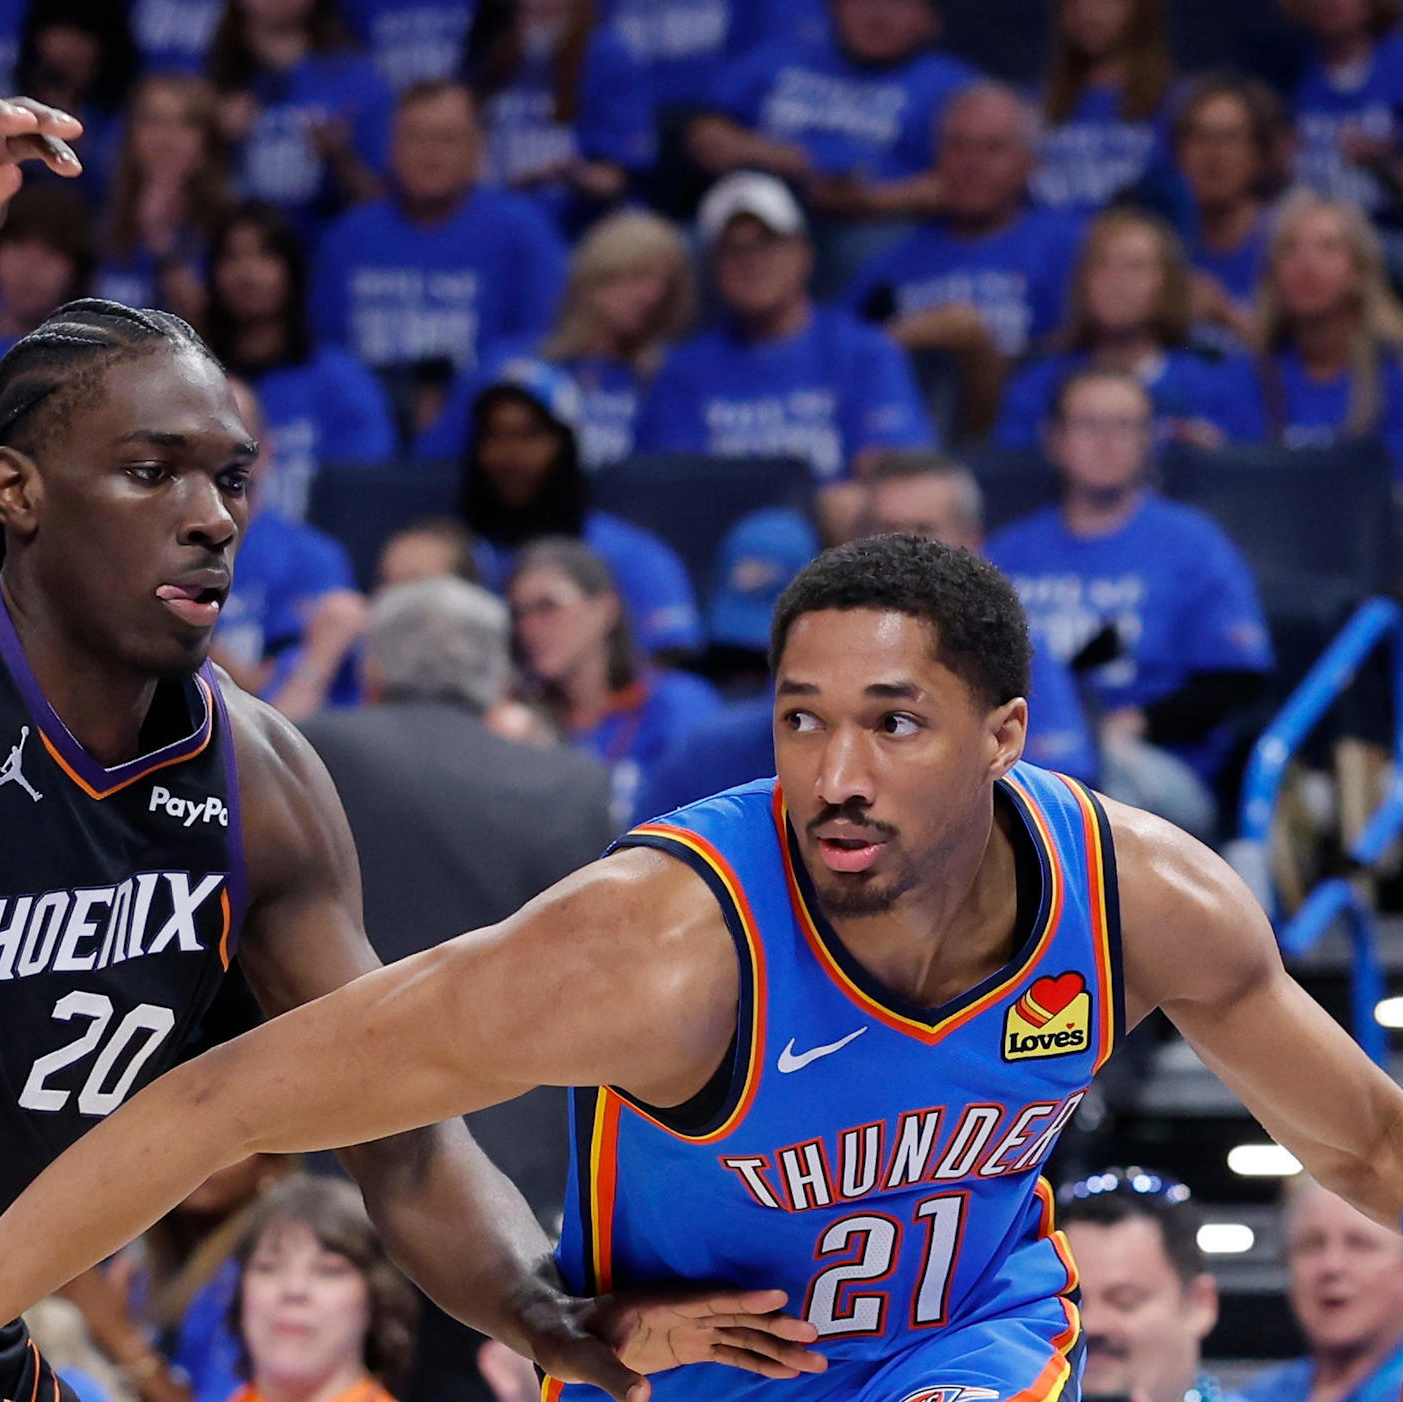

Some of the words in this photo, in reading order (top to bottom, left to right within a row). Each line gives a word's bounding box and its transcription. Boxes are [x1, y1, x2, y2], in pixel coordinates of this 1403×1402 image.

[18, 990, 176, 1116] 20
[721, 1088, 1088, 1213] THUNDER
[804, 1191, 969, 1341] 21
